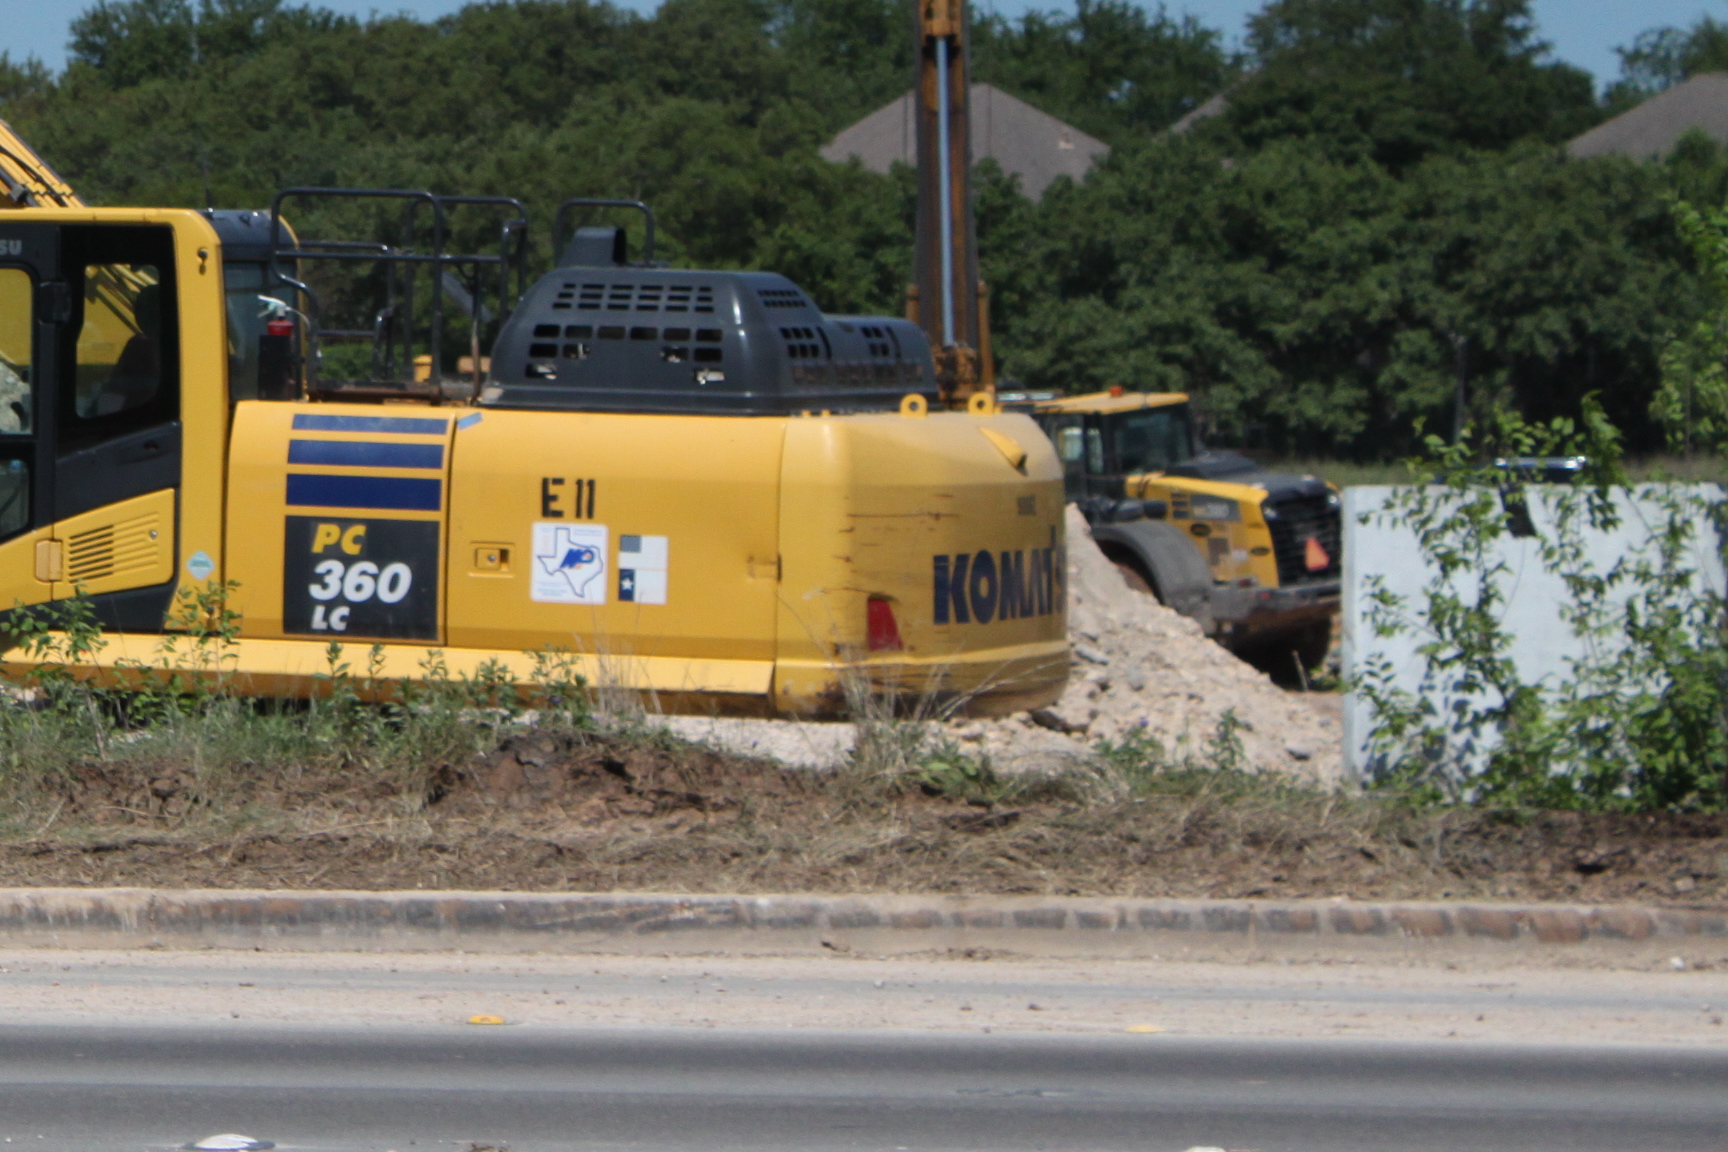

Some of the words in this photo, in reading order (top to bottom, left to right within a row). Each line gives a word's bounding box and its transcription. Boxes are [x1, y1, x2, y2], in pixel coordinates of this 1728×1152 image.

[311, 522, 367, 555] PC
[308, 558, 413, 604] 360
[311, 604, 351, 632] LC
